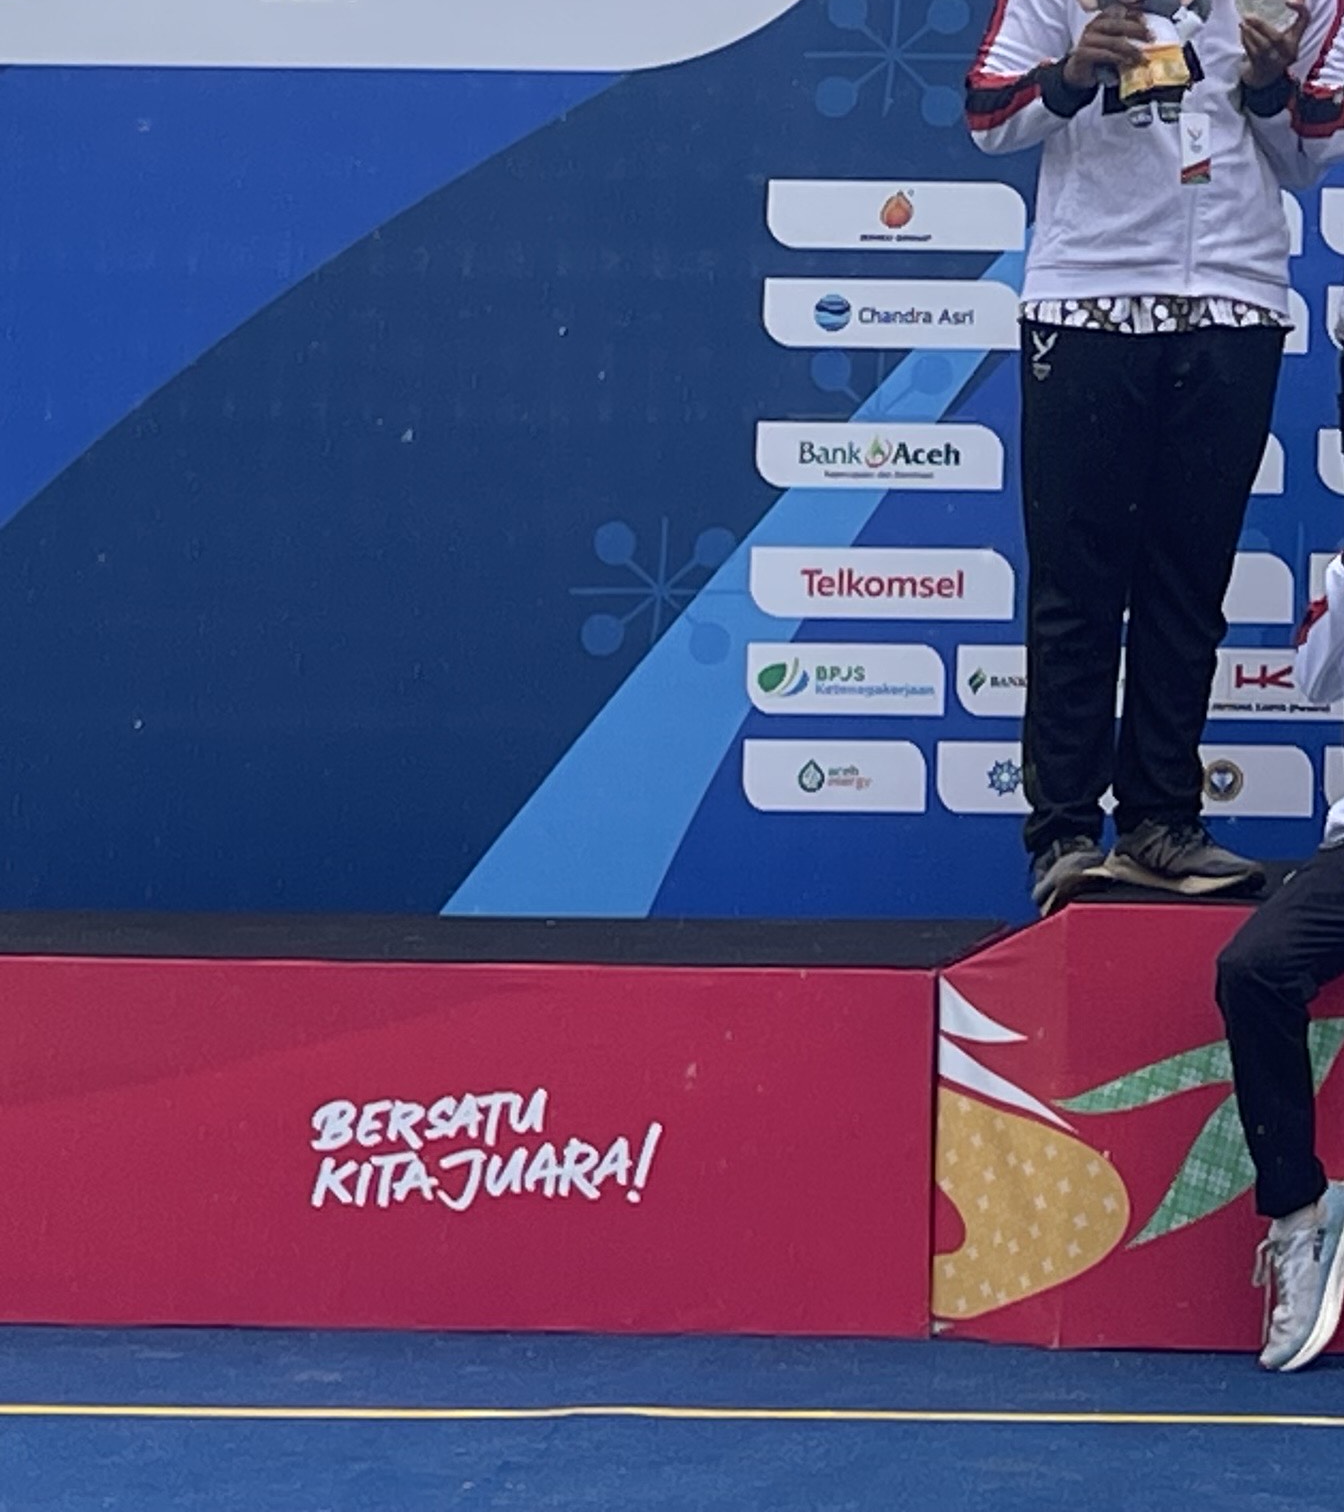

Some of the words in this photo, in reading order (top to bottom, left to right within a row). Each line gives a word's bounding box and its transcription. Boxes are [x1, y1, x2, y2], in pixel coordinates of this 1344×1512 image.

[858, 307, 932, 325] Chandra
[938, 308, 974, 325] Asri
[799, 440, 862, 465] Bank
[892, 442, 961, 466] Aceh
[801, 569, 964, 599] Telkomsel
[815, 666, 866, 681] BPJS
[311, 1088, 548, 1151] BERSATU
[311, 1151, 438, 1208] KITA
[437, 1122, 663, 1211] JUARA!
